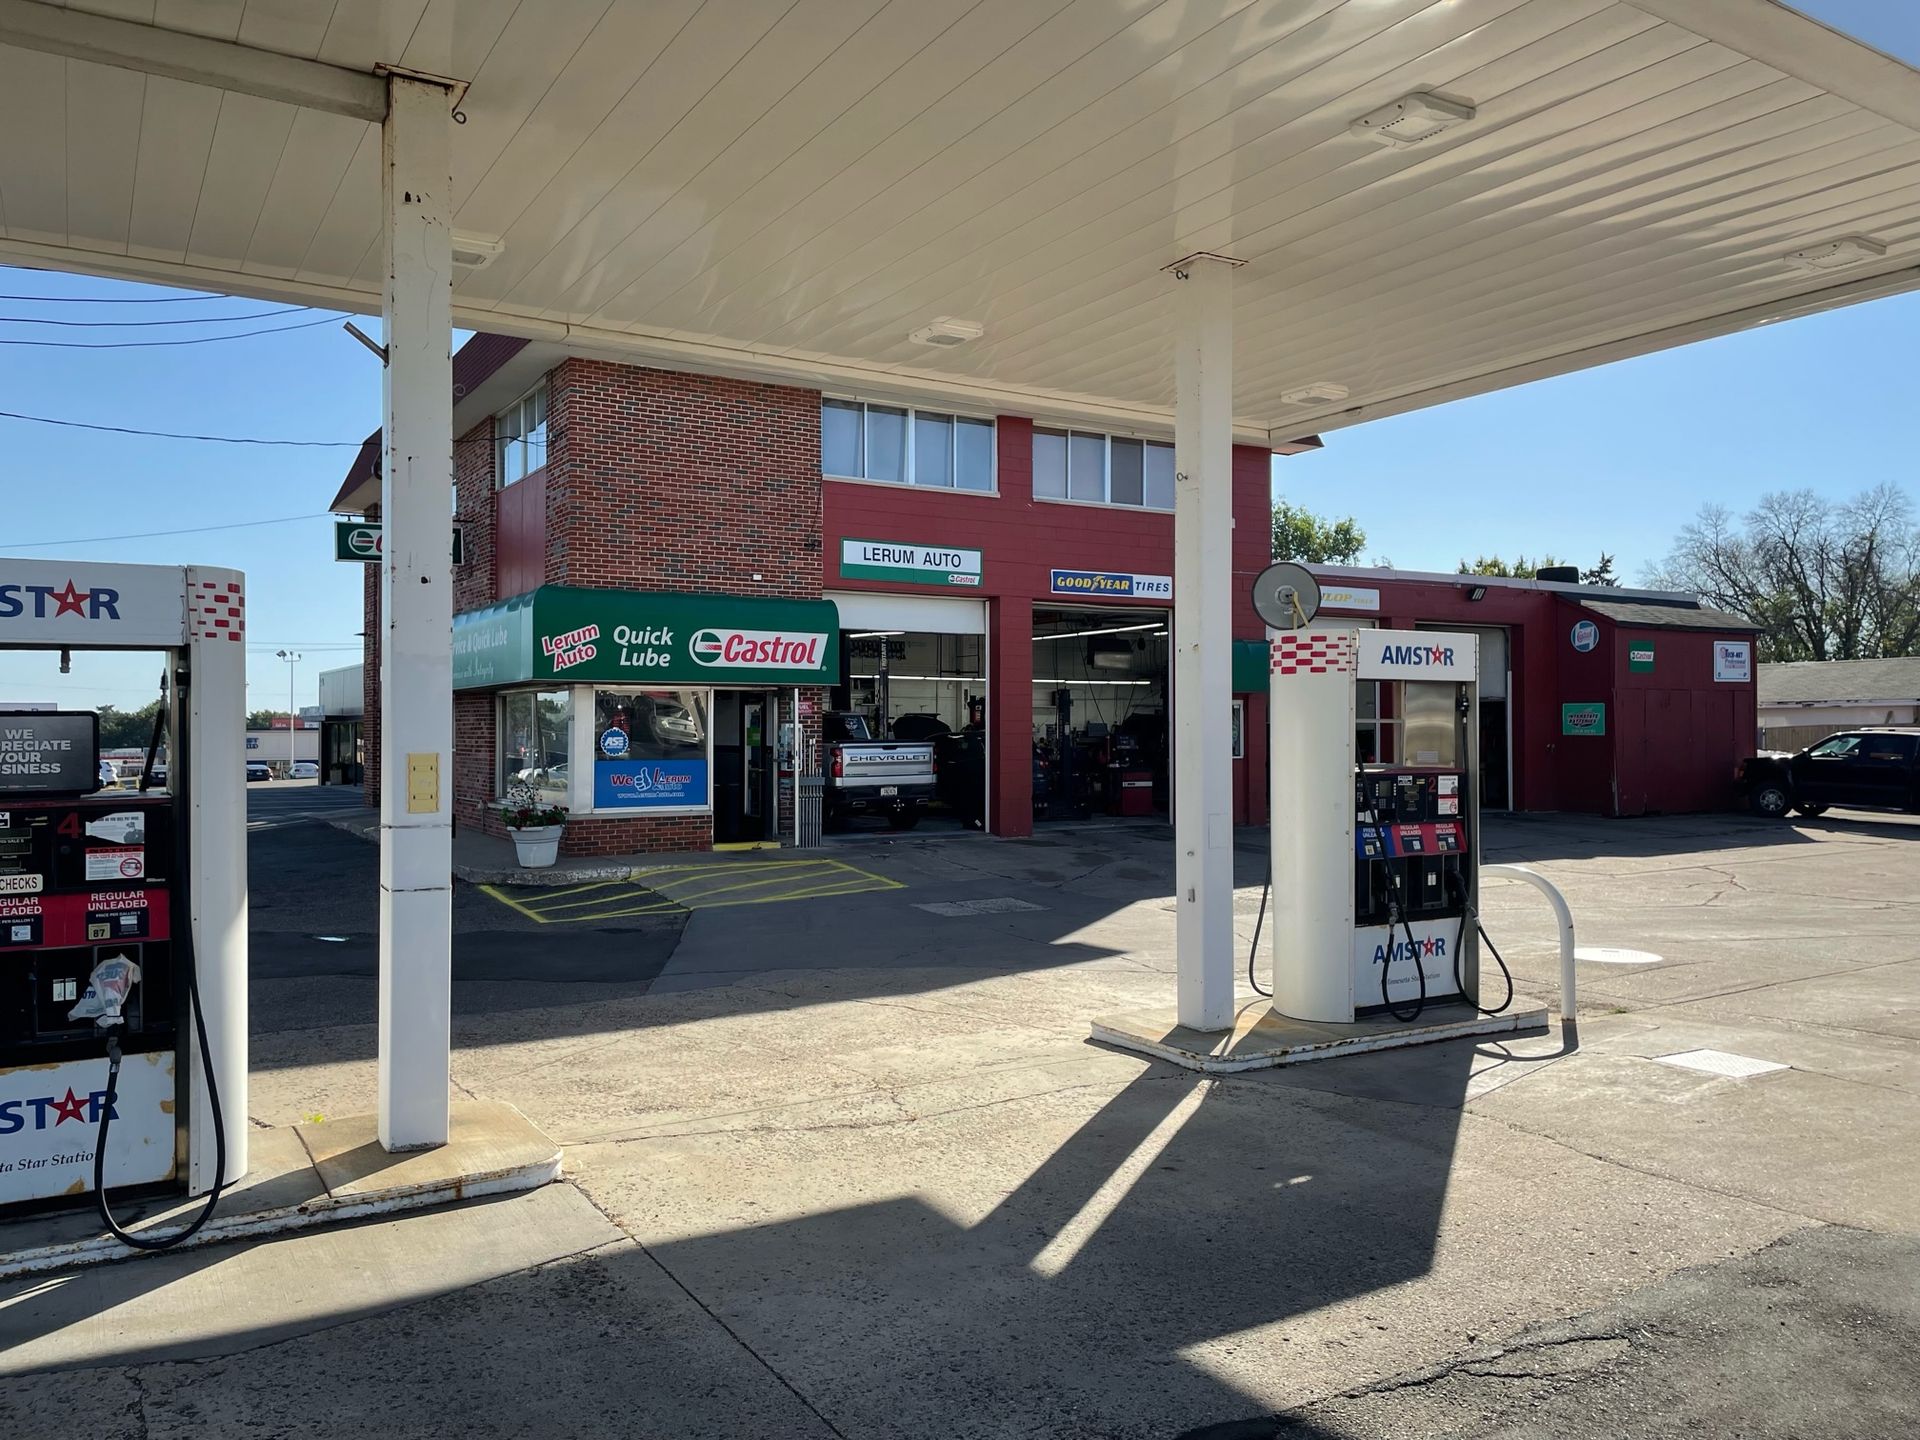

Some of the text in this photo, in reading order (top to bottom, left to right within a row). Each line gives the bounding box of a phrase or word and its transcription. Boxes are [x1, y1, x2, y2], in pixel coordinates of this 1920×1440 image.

[863, 546, 962, 568] LERUM AUTO
[955, 575, 976, 584] Castrol
[1135, 581, 1170, 592] TIRES
[1322, 592, 1353, 602] LOP
[542, 624, 600, 656] Lerum
[613, 625, 674, 646] Quick
[724, 634, 818, 664] Castrol
[1381, 643, 1454, 666] AMSTAR
[553, 644, 597, 672] Auto
[620, 648, 671, 667] Lube
[5, 729, 33, 739] WE
[0, 740, 71, 751] RECIATE
[605, 737, 624, 746] ASE
[0, 763, 61, 774] SINESS
[610, 774, 633, 786] We
[1428, 777, 1436, 793] 2
[57, 812, 82, 838] 4
[0, 877, 37, 891] CHECKS
[91, 890, 144, 901] REGULAR
[87, 899, 148, 911] UNLEADED
[93, 929, 106, 938] 87
[18, 1158, 48, 1171] Star
[51, 1150, 95, 1166] Statio
